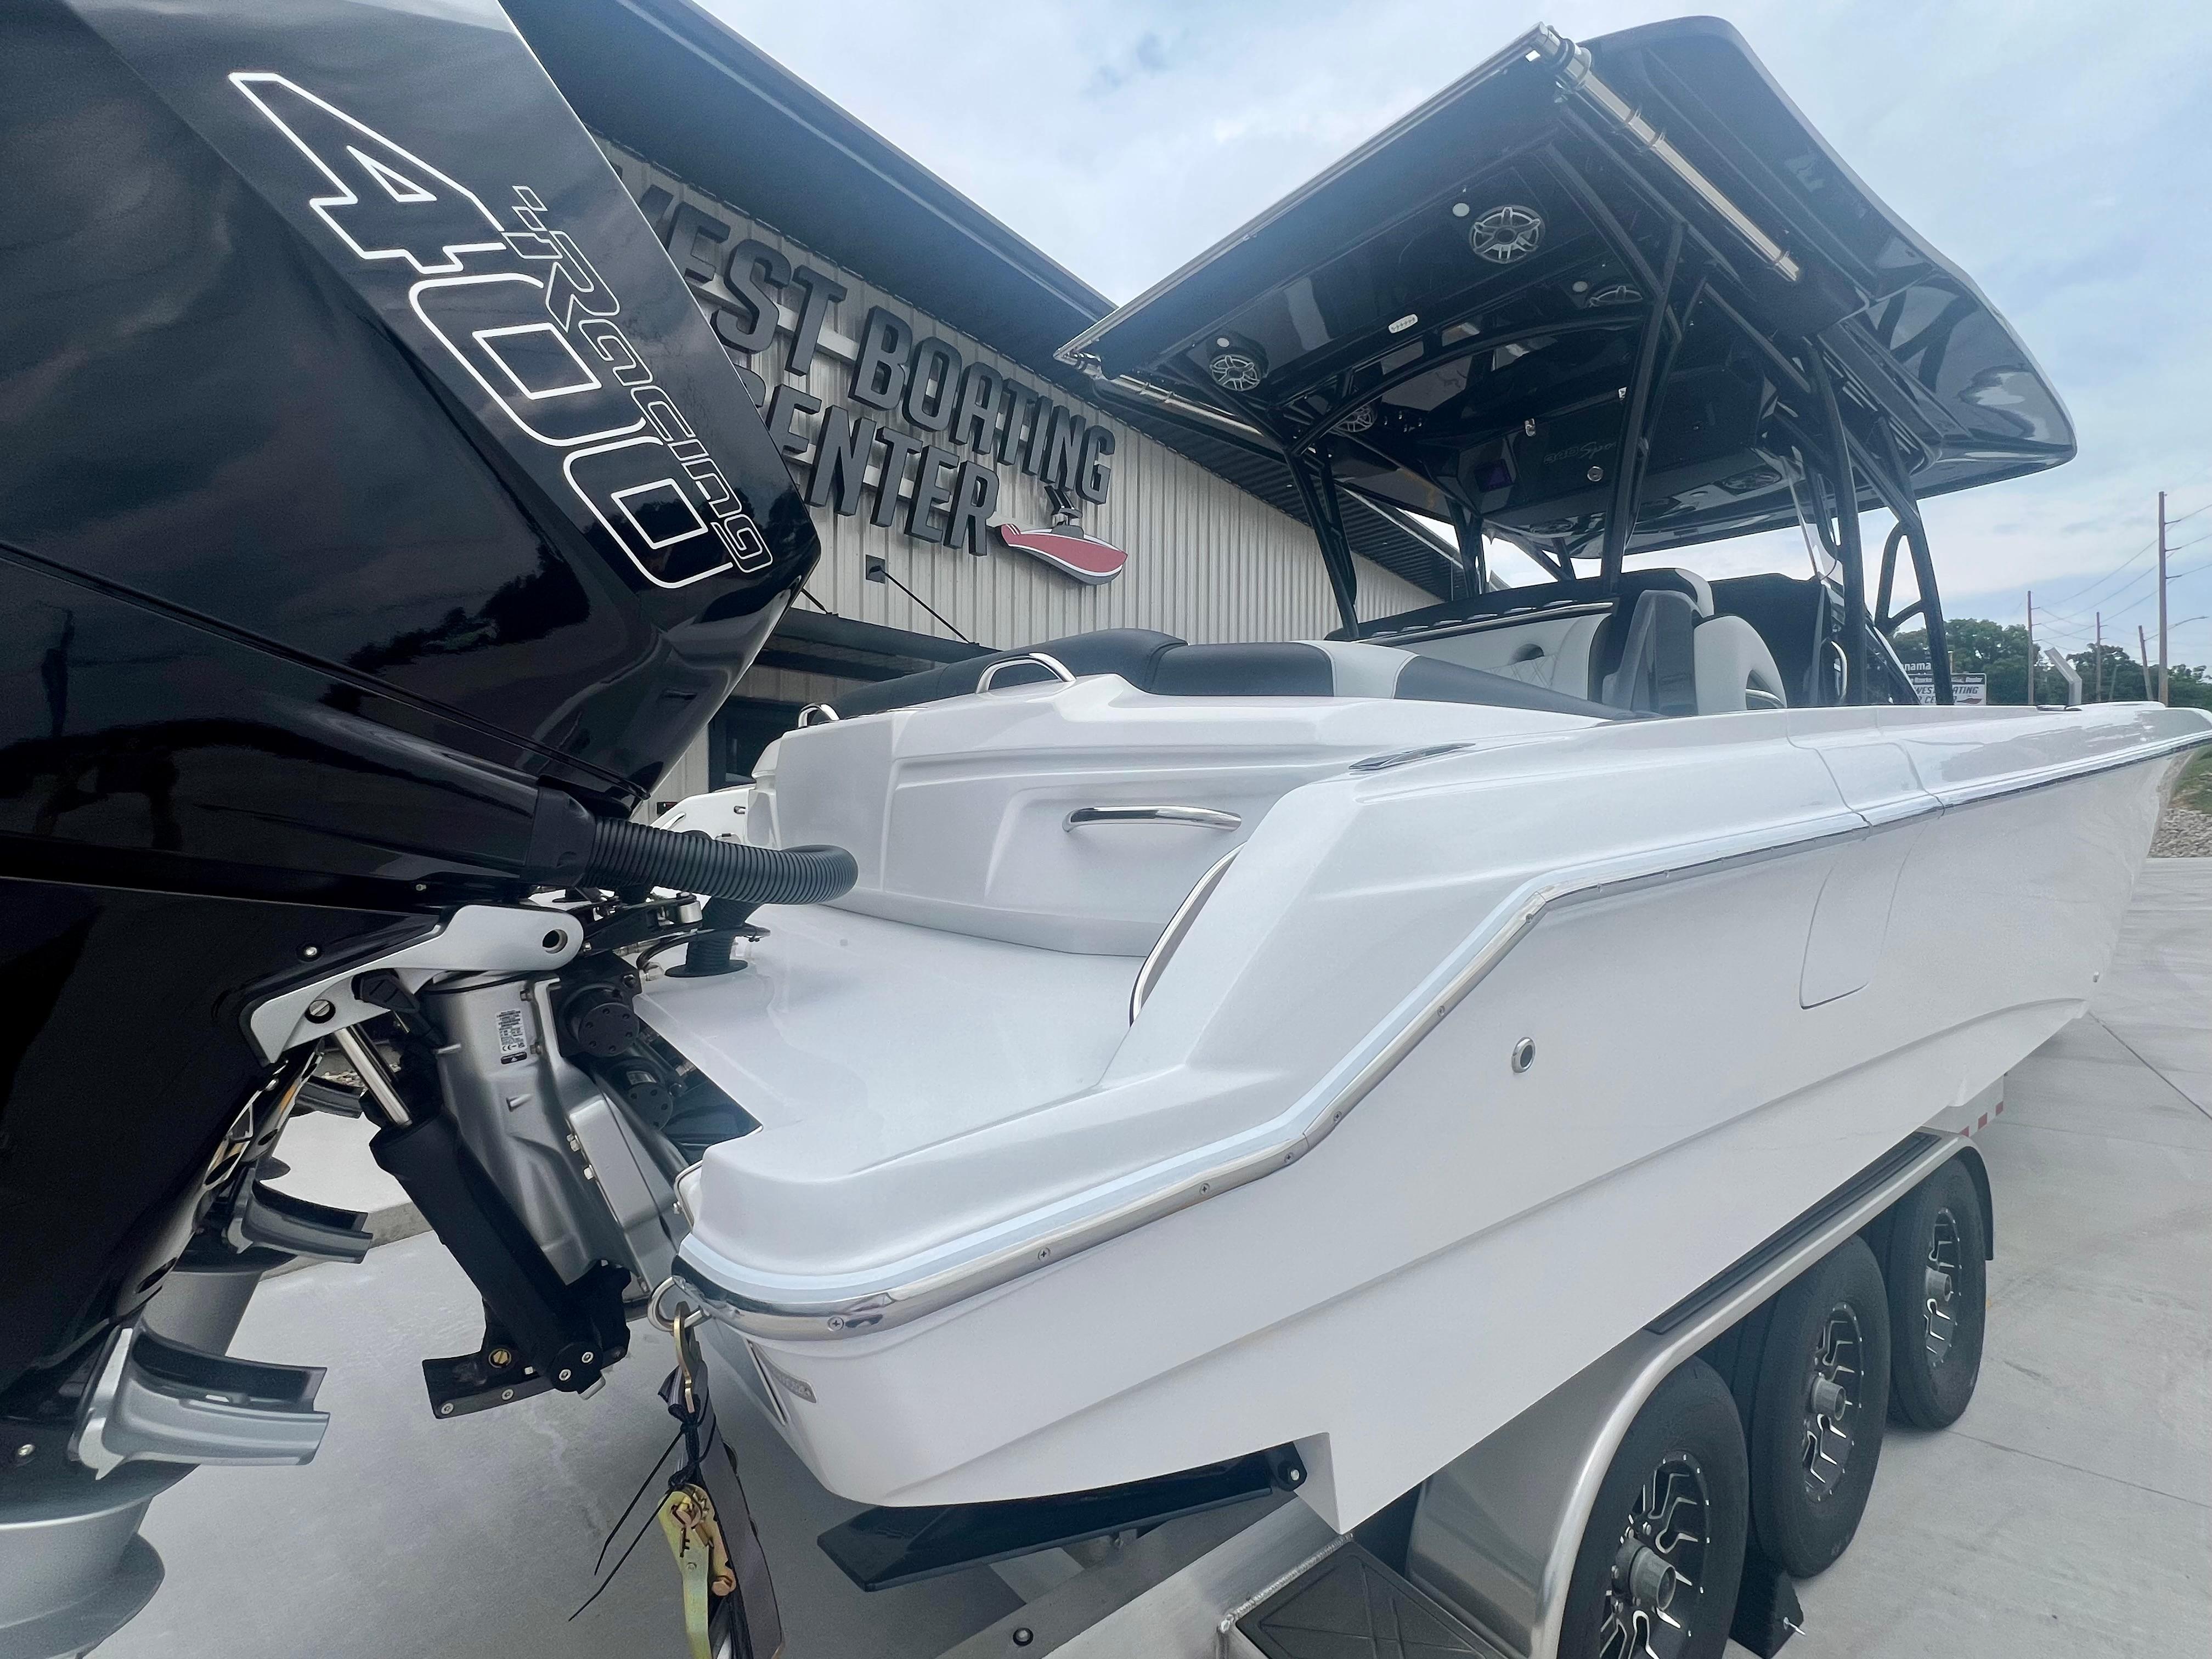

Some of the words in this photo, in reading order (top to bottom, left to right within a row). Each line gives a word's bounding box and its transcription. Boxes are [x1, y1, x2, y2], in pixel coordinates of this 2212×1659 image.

[229, 71, 733, 589] 400
[503, 228, 774, 573] Racing
[631, 184, 847, 376] EST
[849, 305, 1116, 504] BOATING
[1904, 662, 1932, 671] nama
[1953, 686, 1979, 695] ATING
